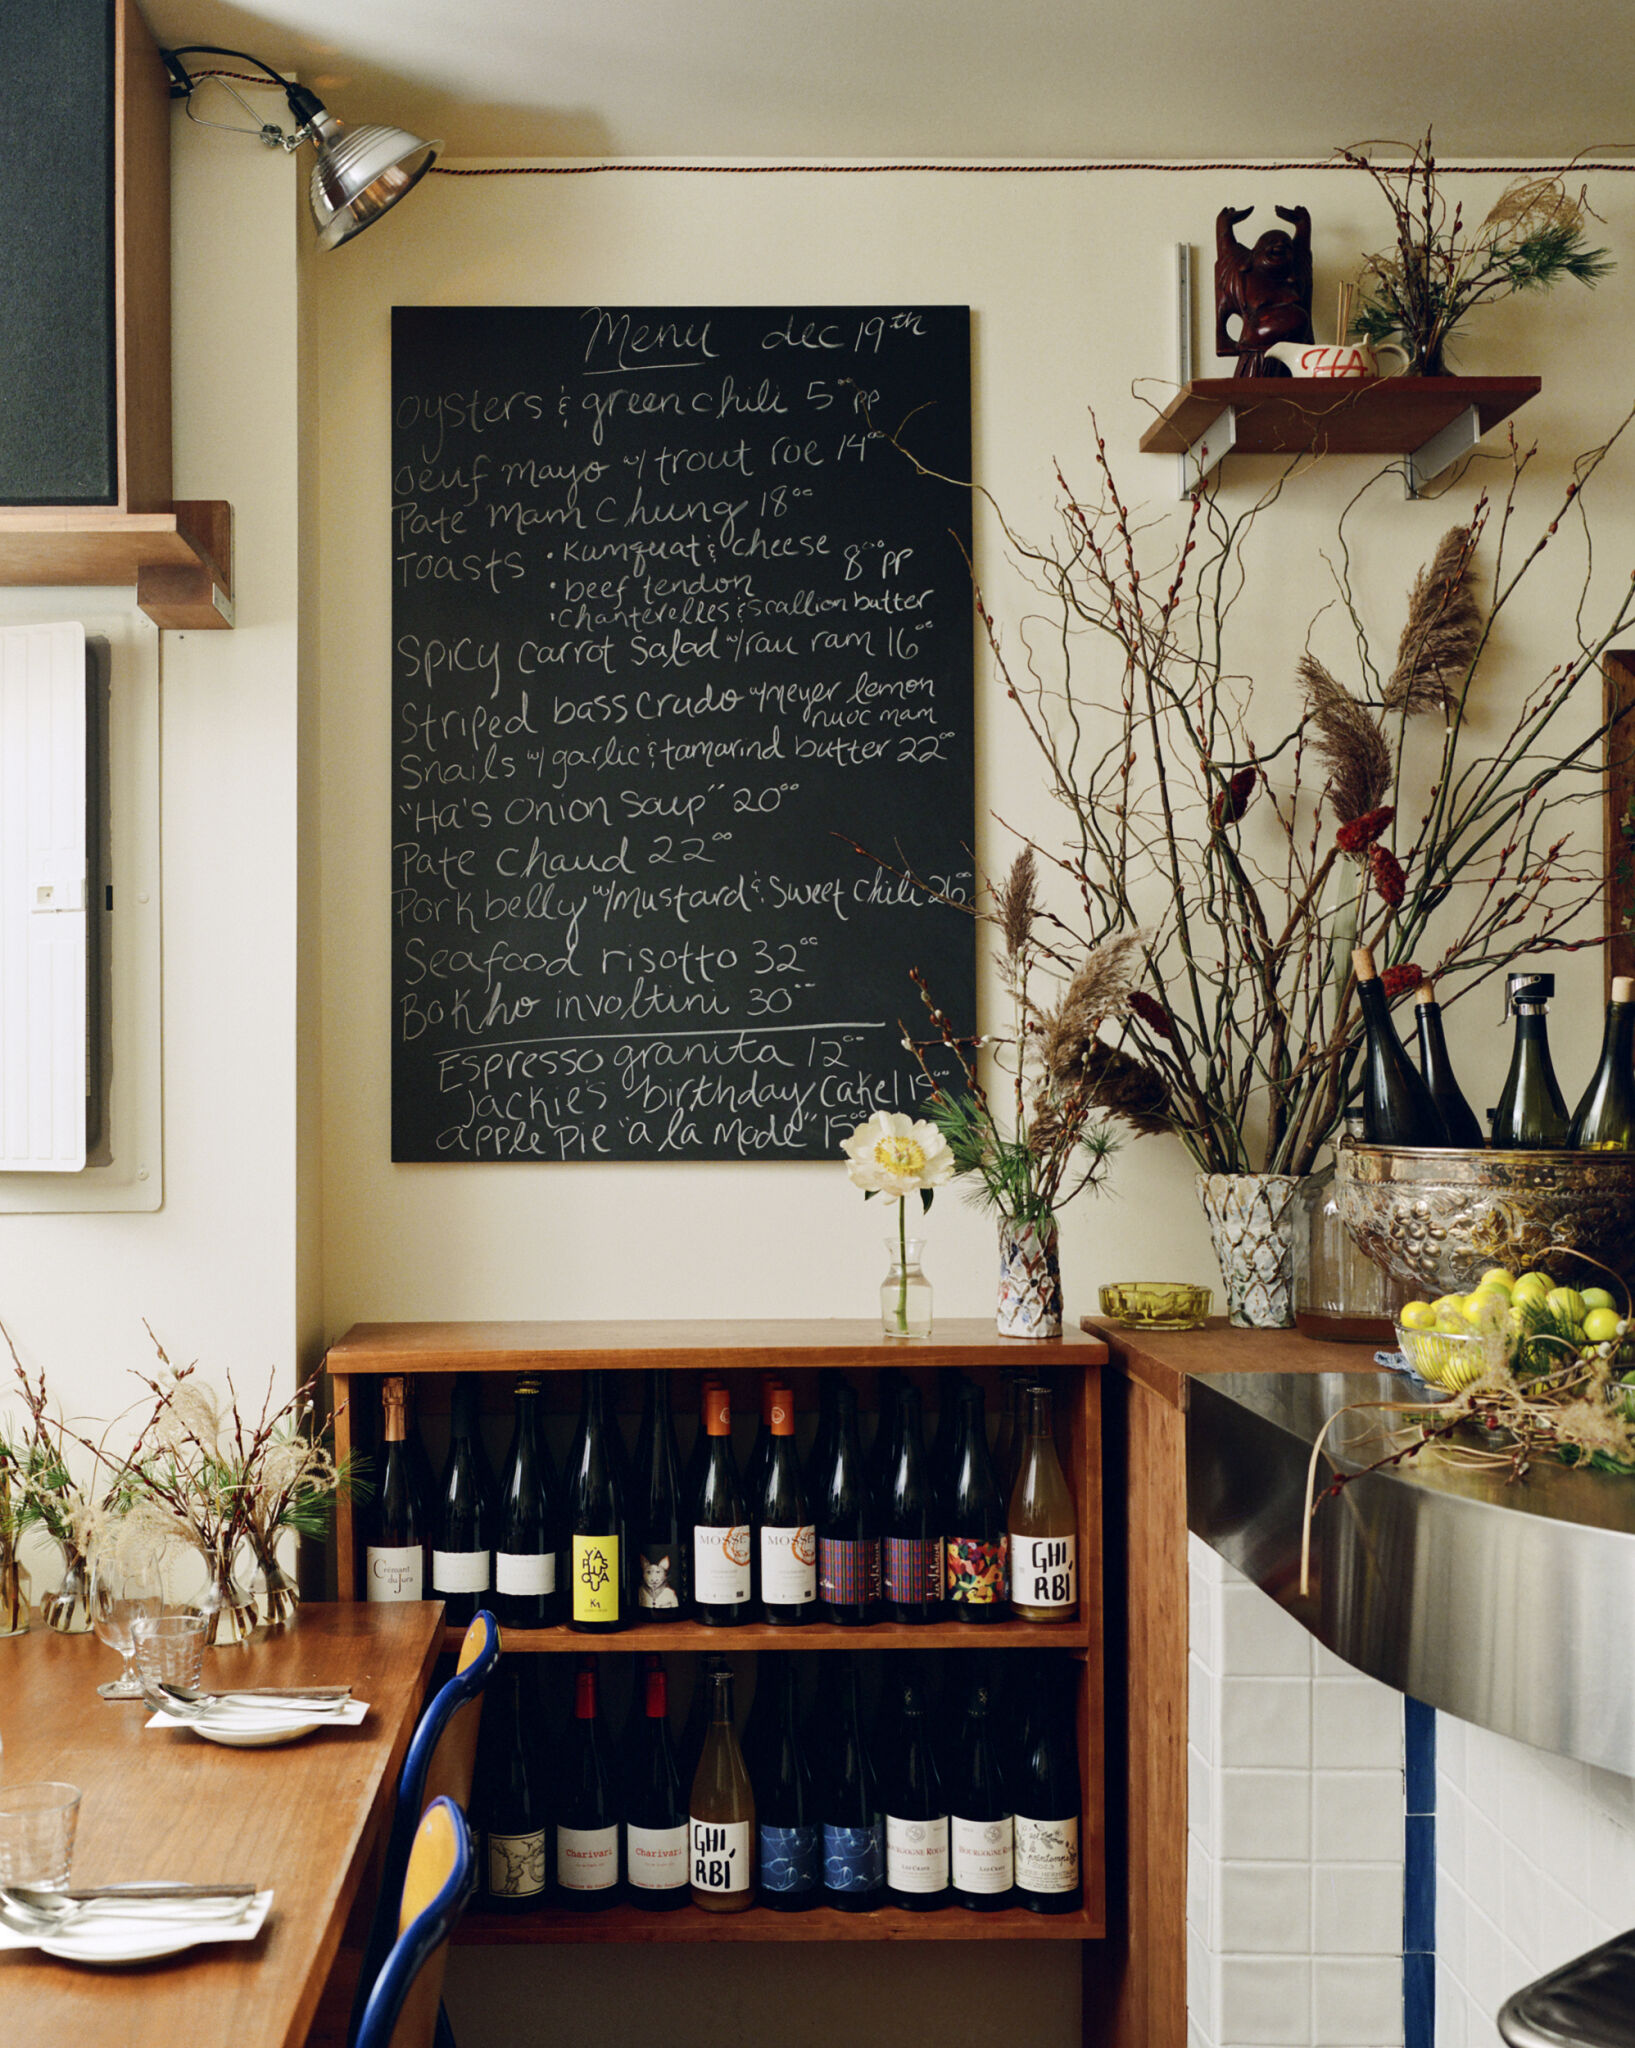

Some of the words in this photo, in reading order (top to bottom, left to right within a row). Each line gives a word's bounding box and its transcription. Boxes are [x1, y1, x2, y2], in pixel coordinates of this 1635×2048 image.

[580, 306, 720, 371] Menu
[581, 389, 685, 446] green
[691, 375, 788, 420] chili
[653, 439, 754, 486] trout
[771, 435, 824, 466] roe
[731, 527, 831, 560] cheese
[565, 575, 630, 610] beef
[643, 572, 755, 605] tendon
[853, 588, 934, 614] butter
[811, 630, 876, 657] ram
[400, 689, 539, 753] Striped
[554, 693, 629, 725] bass
[846, 670, 936, 705] lemon
[400, 741, 517, 790] Snails
[551, 735, 641, 790] garlic
[660, 724, 786, 770] tamarind
[795, 735, 893, 768] butter
[485, 881, 588, 951] belly
[404, 937, 584, 994] Seafood
[601, 940, 738, 985] risotto
[555, 976, 730, 1022] involtini
[613, 1030, 796, 1091] granita
[657, 1106, 704, 1152] la
[565, 1848, 613, 1859] Charivari
[635, 1847, 683, 1858] Charivari
